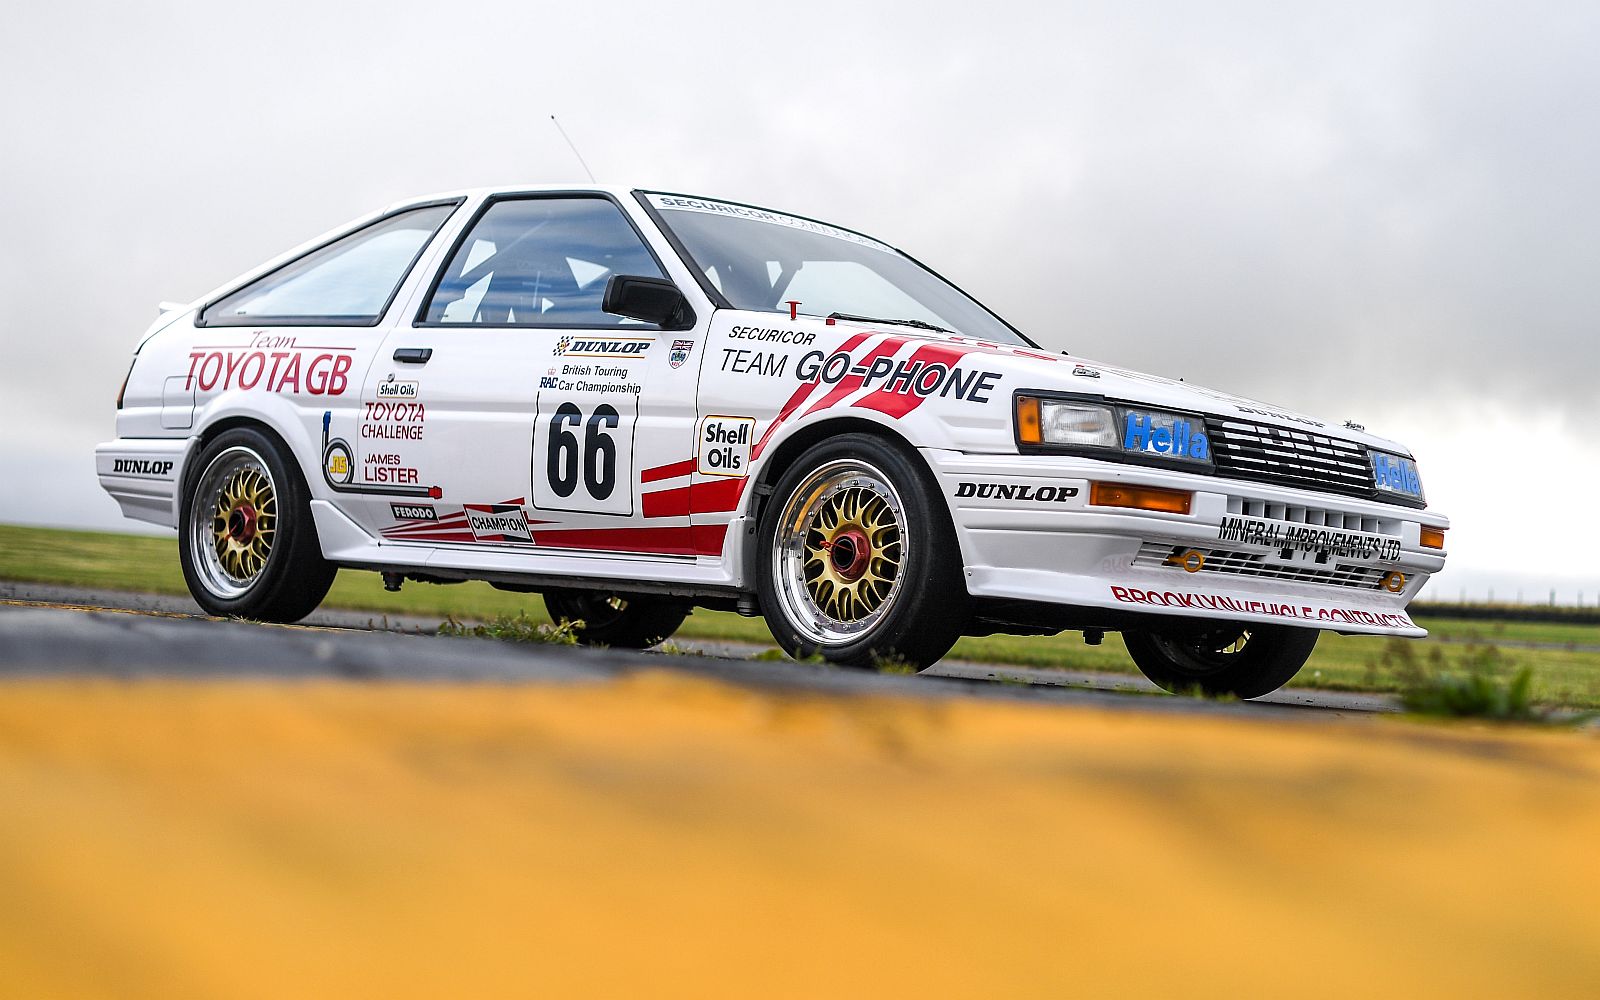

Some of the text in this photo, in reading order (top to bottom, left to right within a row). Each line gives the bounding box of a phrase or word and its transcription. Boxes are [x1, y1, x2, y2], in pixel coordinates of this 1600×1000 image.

[659, 197, 777, 221] SECURICOR
[250, 330, 297, 349] Team
[728, 325, 816, 346] SECURICOR
[569, 341, 651, 354] DUNLOP
[561, 364, 629, 380] British Touring
[719, 348, 1003, 403] TEAM GO-PHONE
[380, 383, 415, 396] Shell Oils
[539, 376, 559, 389] RAC
[558, 380, 642, 396] Car Championship
[364, 402, 425, 422] TOYOTA
[361, 424, 424, 440] CHALLENGE
[705, 422, 749, 445] Shell
[1124, 411, 1208, 460] Hella
[364, 453, 401, 465] JAMES
[546, 401, 620, 501] 66
[707, 448, 741, 470] Oils
[113, 458, 174, 476] DUNLOP
[364, 466, 419, 484] LISTER
[1374, 452, 1420, 496] Hella
[954, 482, 1079, 502] DUNLOP
[393, 506, 434, 519] FERODO
[471, 516, 526, 532] CHAMPION
[1217, 516, 1281, 547] MINERAL
[1273, 525, 1381, 560] IMPROVEMENTS
[1110, 585, 1413, 628] BROOKLYN VEHICLE CONTRACTS
